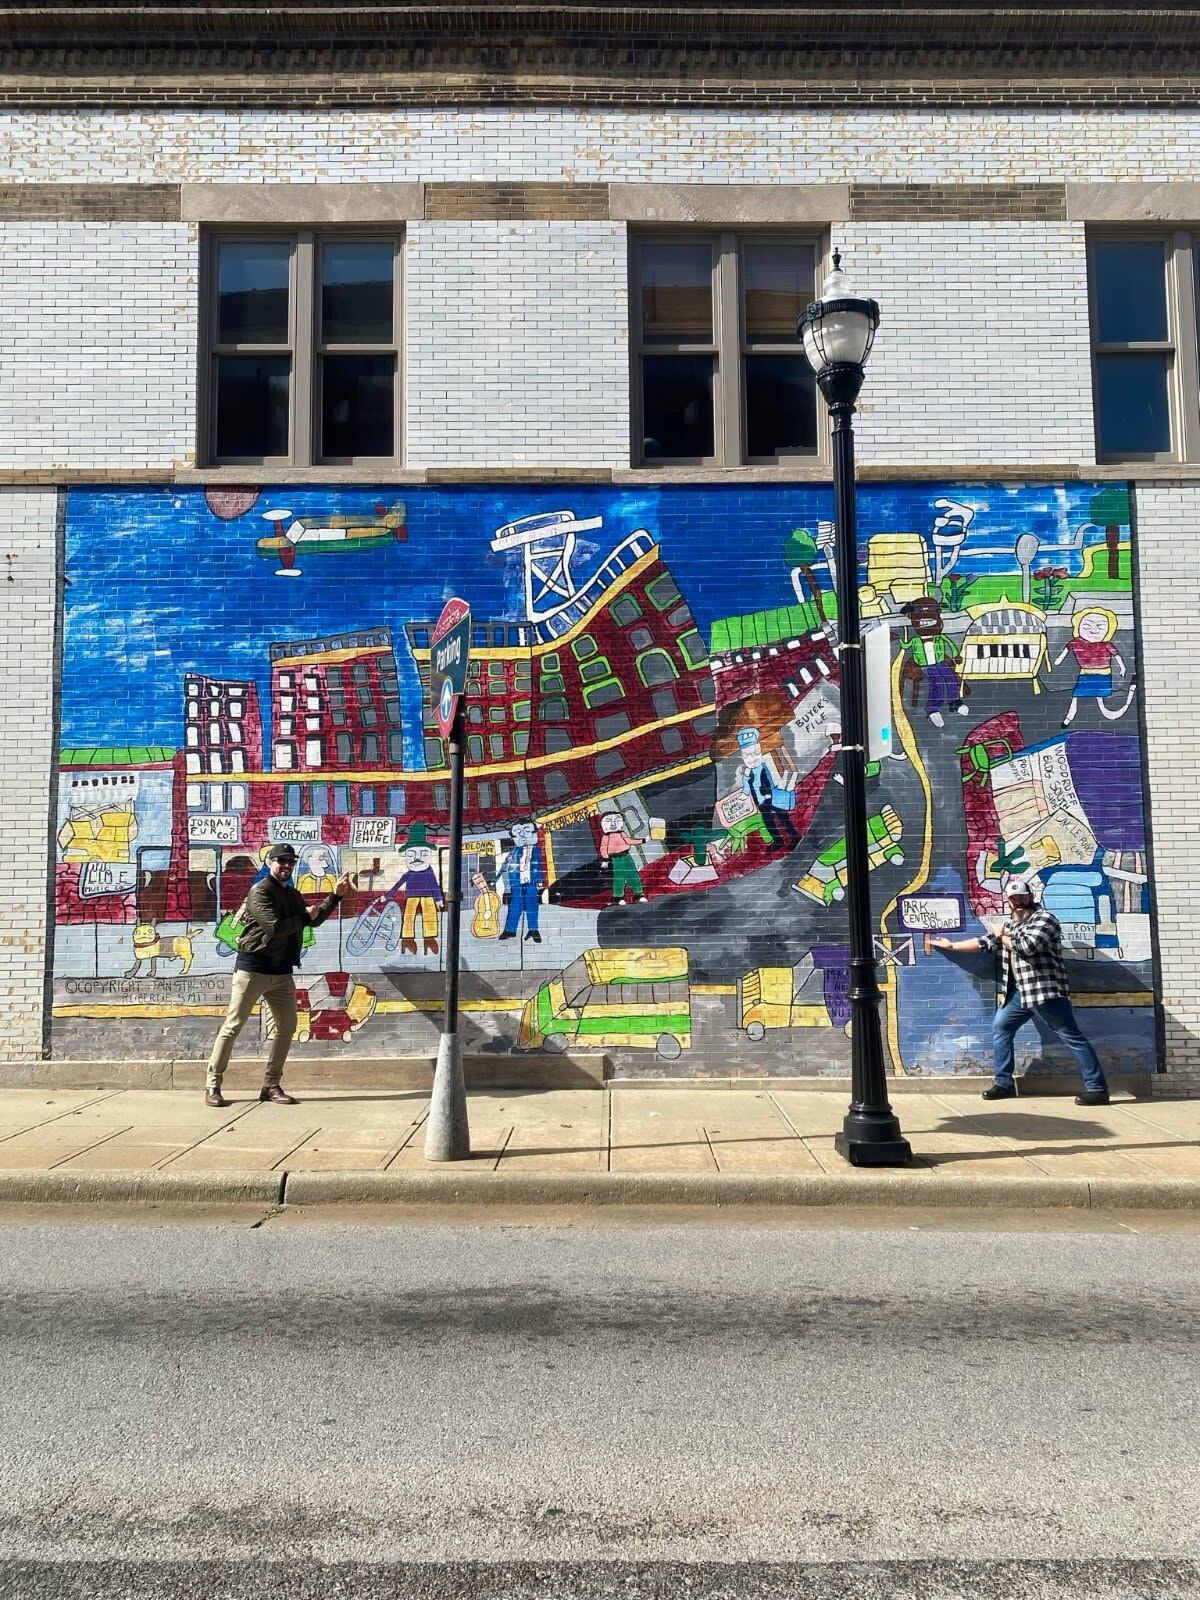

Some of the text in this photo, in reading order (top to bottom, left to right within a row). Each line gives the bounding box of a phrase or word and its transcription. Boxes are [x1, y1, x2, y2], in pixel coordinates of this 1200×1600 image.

[437, 636, 460, 674] Parking
[795, 697, 829, 728] BUYER'S
[805, 712, 828, 733] FILE
[1018, 758, 1030, 777] POST
[1054, 745, 1078, 806] WOODRUFF
[1045, 793, 1059, 810] SIDE
[1049, 781, 1070, 810] SOUTH
[190, 818, 232, 827] JORDAN
[1055, 813, 1082, 838] UNCLE
[190, 826, 217, 835] FUR
[275, 830, 318, 840] PORTRAIT
[355, 836, 389, 844] SHINE
[903, 900, 928, 913] PARK
[903, 910, 938, 923] CENTRAL
[923, 918, 960, 929] SQUARE
[1073, 923, 1095, 932] POST
